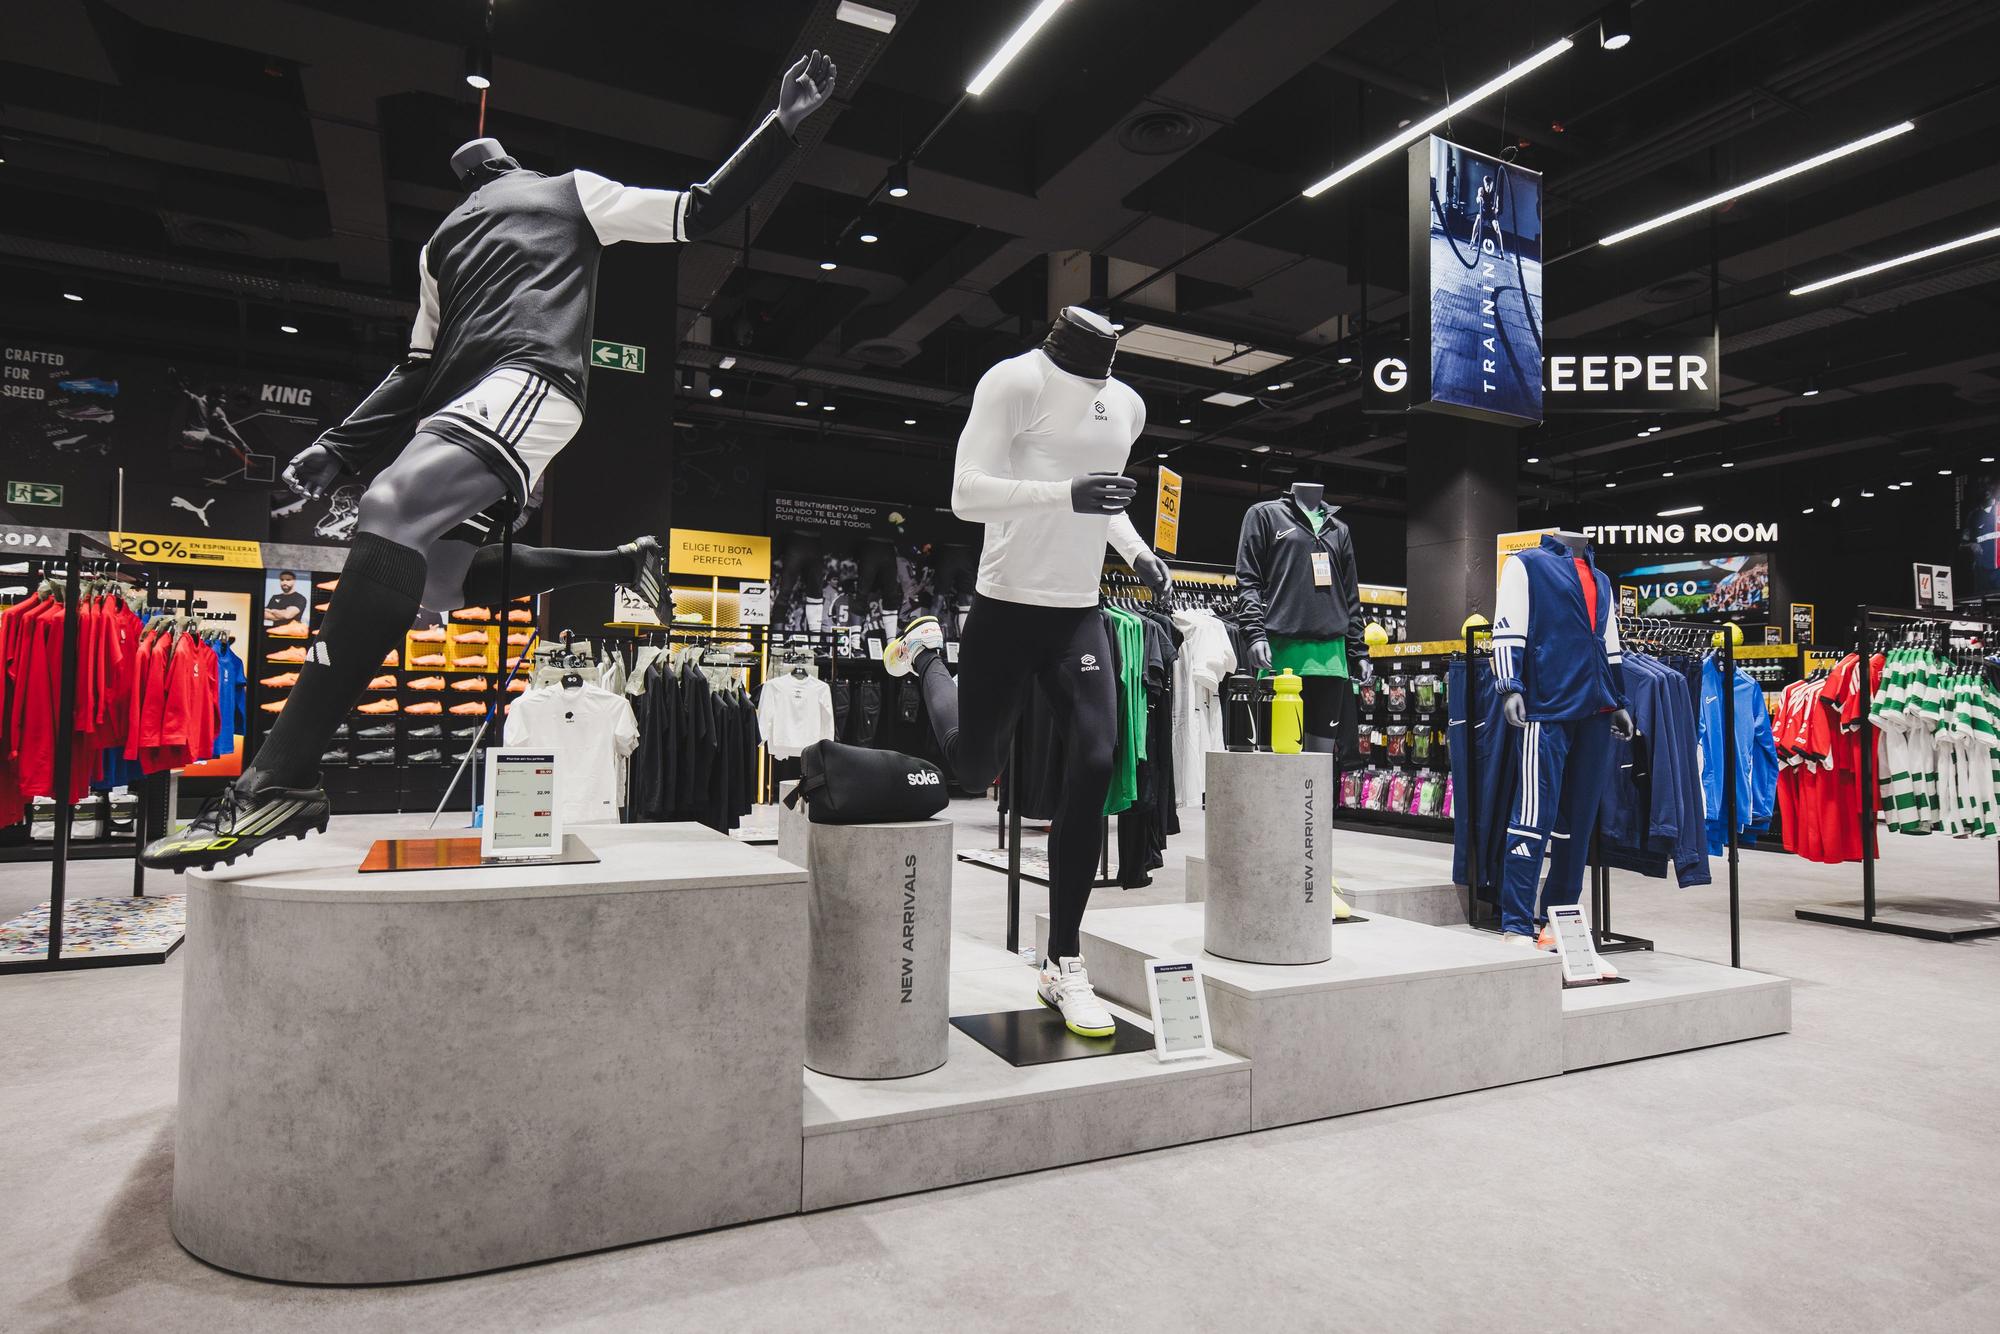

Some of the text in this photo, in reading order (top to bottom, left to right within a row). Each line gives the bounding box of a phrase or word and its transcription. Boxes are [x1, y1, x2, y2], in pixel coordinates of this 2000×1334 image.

[1483, 238, 1496, 393] TRAINING
[5, 348, 64, 366] CRAFTED
[4, 366, 30, 380] FOR
[1373, 355, 1708, 392] GEEPER
[3, 384, 45, 400] SPEED
[261, 384, 312, 406] KING
[776, 506, 812, 515] CUANDO
[827, 511, 858, 520] ELEVAS
[794, 500, 849, 512] SENTIMIENTO
[795, 516, 827, 524] ENCIMA
[0, 532, 52, 548] OPA
[1582, 523, 1778, 544] FITTING ROOM
[203, 544, 258, 553] ESPINILLERAS
[683, 542, 753, 555] ELIGE TU BOTA
[693, 555, 742, 566] PERFECTA
[1639, 580, 1697, 599] VIGO
[1793, 613, 1812, 622] 40%
[1404, 645, 1422, 654] KIDS
[907, 770, 940, 785] soka
[1305, 778, 1313, 903] NEW ARRIVALS
[901, 854, 917, 1004] NEW ARRIVALS
